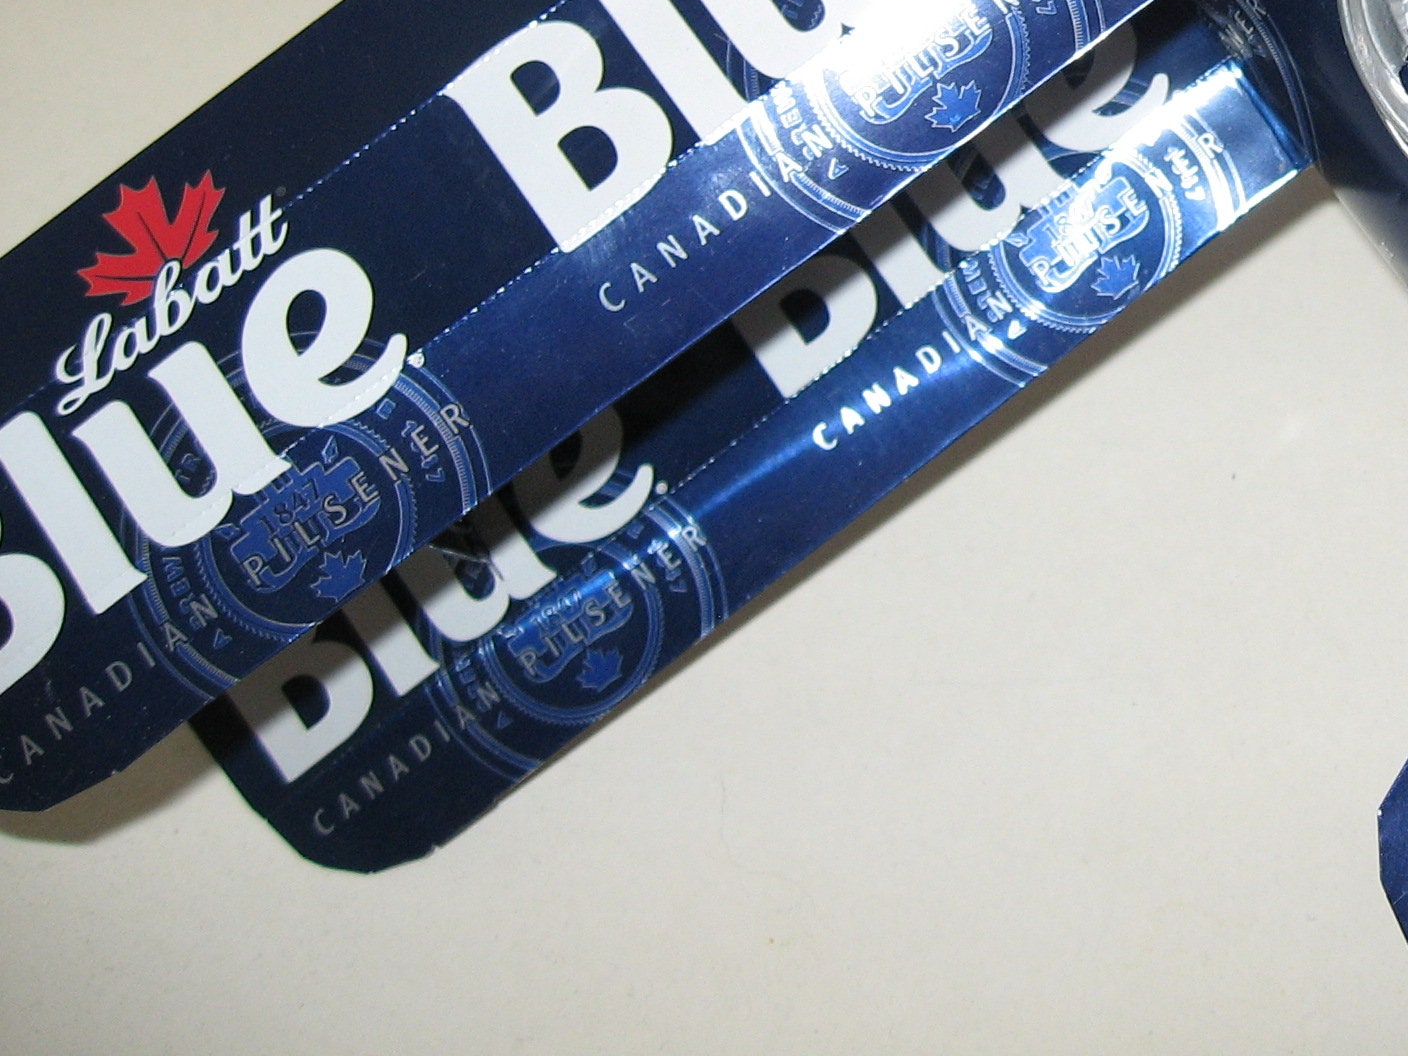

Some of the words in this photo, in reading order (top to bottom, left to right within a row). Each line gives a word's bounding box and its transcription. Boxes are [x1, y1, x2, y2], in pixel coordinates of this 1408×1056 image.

[54, 193, 290, 416] Labatt
[599, 124, 833, 312] CANADIAN
[0, 248, 407, 695] lue
[811, 289, 1013, 451] CANADIAN
[241, 404, 469, 589] PILSENER
[313, 682, 500, 837] CANADIAN
[520, 524, 708, 677] PILSENER
